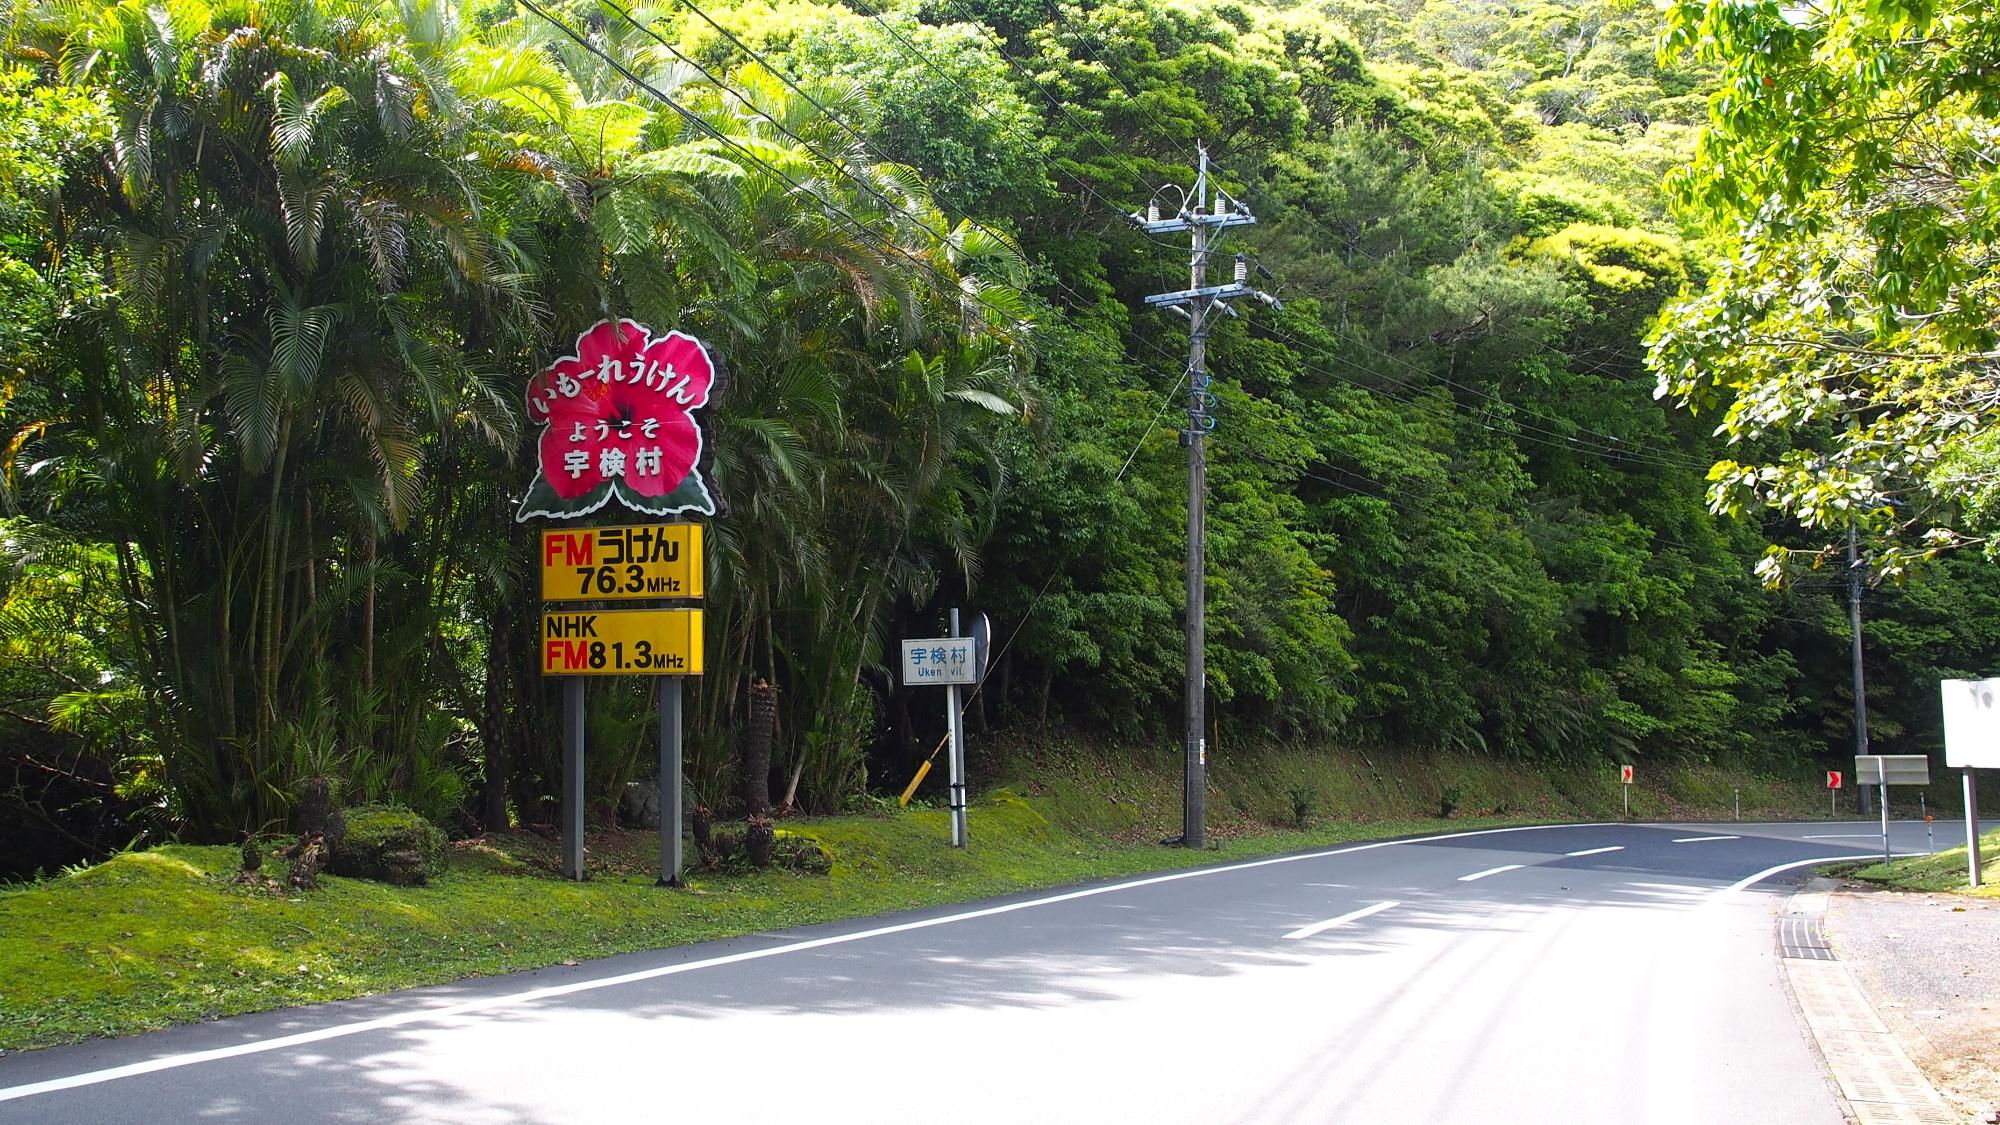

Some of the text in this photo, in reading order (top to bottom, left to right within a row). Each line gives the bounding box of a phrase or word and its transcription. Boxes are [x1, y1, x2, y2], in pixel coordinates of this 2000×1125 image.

[532, 352, 696, 414] いもーれうけん
[569, 417, 661, 442] ようこそ
[564, 446, 664, 480] 宇検村
[545, 527, 679, 567] FM うけん
[546, 615, 598, 639] NHK
[910, 646, 967, 665] 宇検村
[918, 666, 942, 677] Uken
